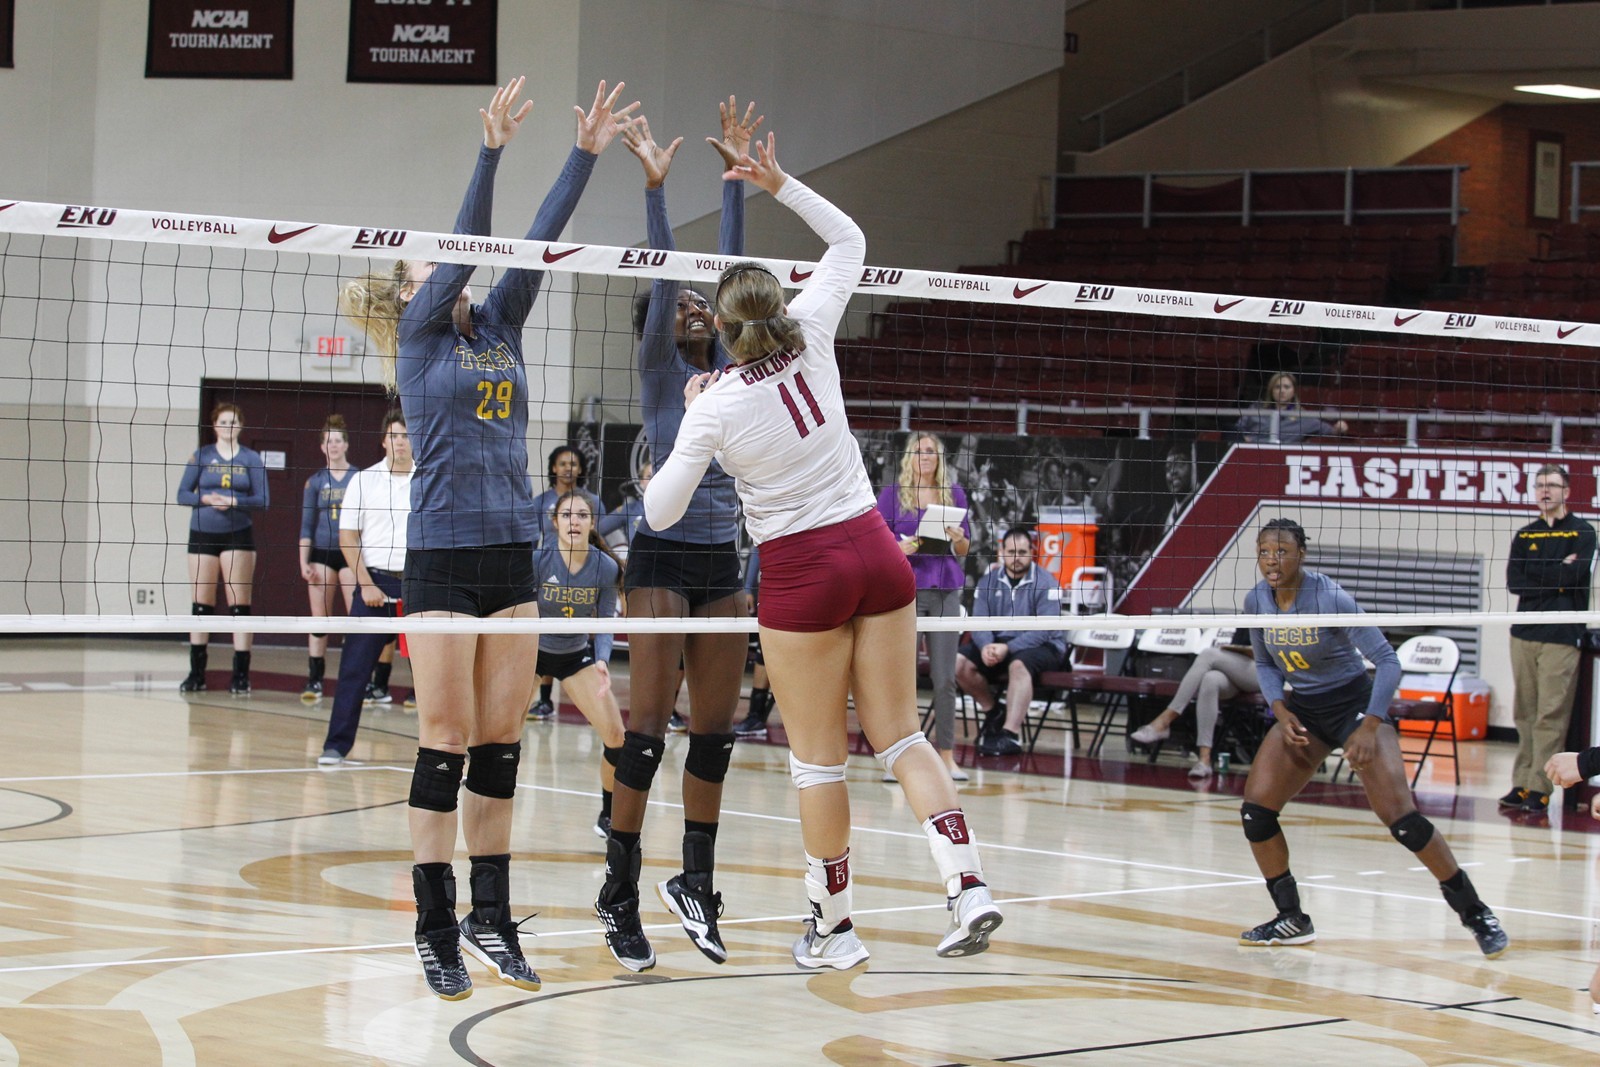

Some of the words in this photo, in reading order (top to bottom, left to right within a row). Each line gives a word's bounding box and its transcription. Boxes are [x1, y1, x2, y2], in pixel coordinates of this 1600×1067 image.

[191, 10, 249, 28] NCAA
[169, 33, 274, 48] TOURNAMENT
[392, 24, 450, 43] NCAA
[369, 47, 475, 64] TOURNAMENT
[57, 205, 118, 228] EKU
[152, 217, 238, 235] VOLLEYBALL
[352, 228, 407, 249] EKU
[438, 239, 515, 255] VOLLEYBALL
[618, 249, 668, 268] EKU
[696, 259, 734, 272] VOLLE
[858, 267, 904, 287] EKU
[928, 277, 991, 292] VOLLEYBALL
[1075, 285, 1115, 303] EKU
[1137, 293, 1194, 307] VOLLEYBALL
[1269, 300, 1305, 317] EKU
[1325, 308, 1376, 321] VOLLEYBALL
[1443, 313, 1477, 330] EKU
[1495, 320, 1541, 333] VOLLEYBALL
[318, 336, 345, 357] EXIT
[476, 380, 513, 420] 29
[777, 371, 826, 439] 11
[221, 473, 232, 489] 6
[1044, 534, 1060, 554] G
[542, 583, 598, 605] TECH
[1264, 627, 1319, 646] TECH
[1278, 650, 1311, 673] 18
